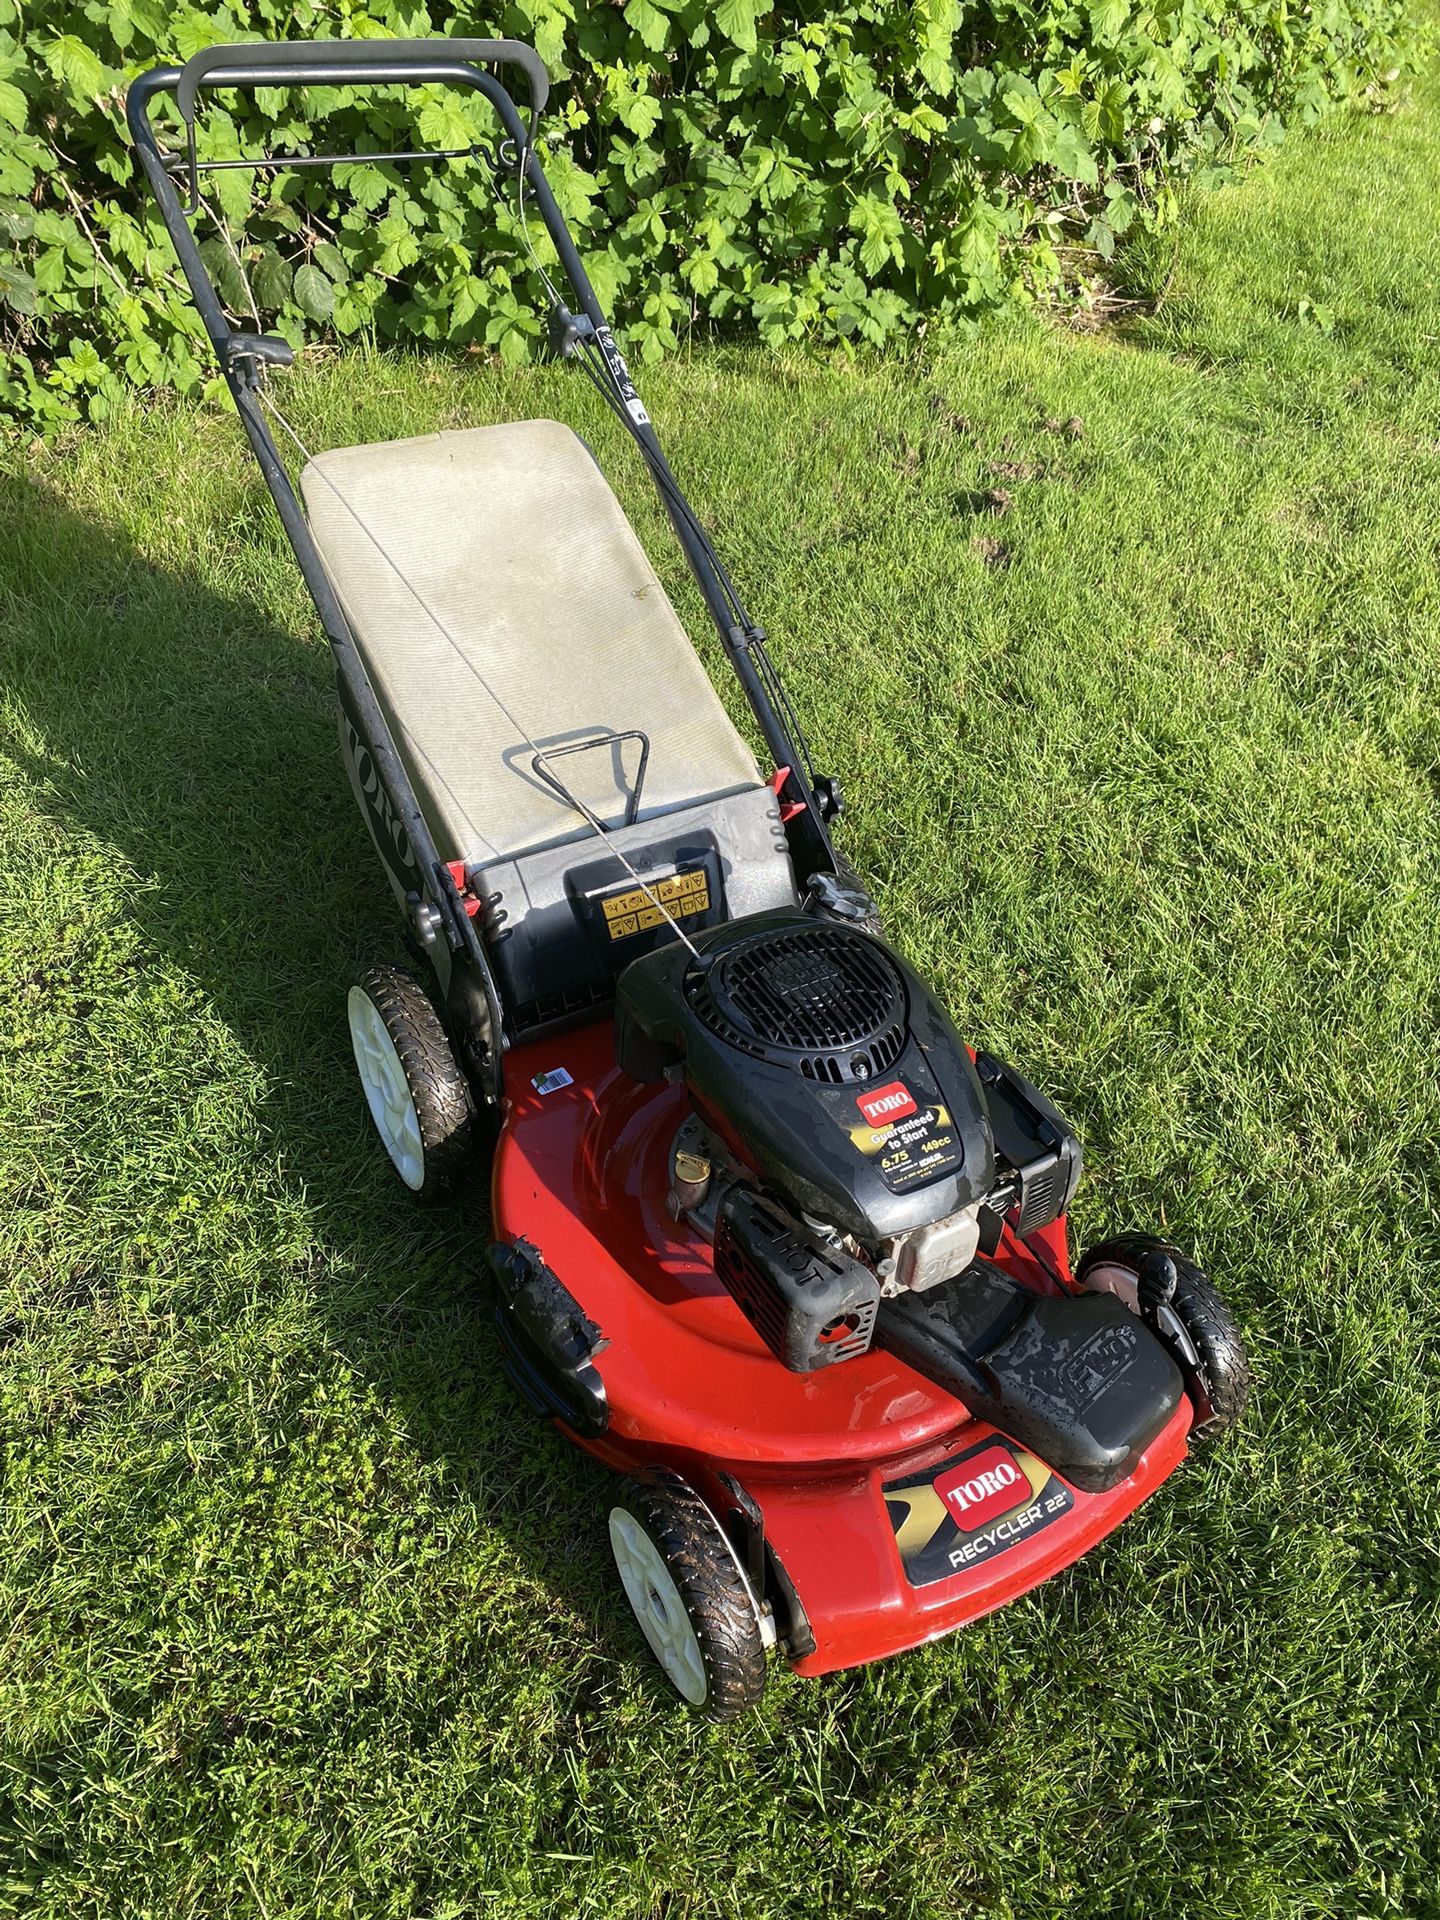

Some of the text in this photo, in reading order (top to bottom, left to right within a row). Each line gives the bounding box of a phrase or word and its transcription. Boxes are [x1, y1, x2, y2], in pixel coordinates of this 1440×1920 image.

[865, 1091, 911, 1118] TORO
[871, 1110, 935, 1144] Guaranteed
[888, 1127, 929, 1150] to Start
[881, 1150, 909, 1168] 6.75
[921, 1136, 952, 1152] 149cc
[771, 1232, 825, 1286] HOT
[947, 1463, 1018, 1512] TORO
[948, 1503, 1045, 1568] RECYCLER
